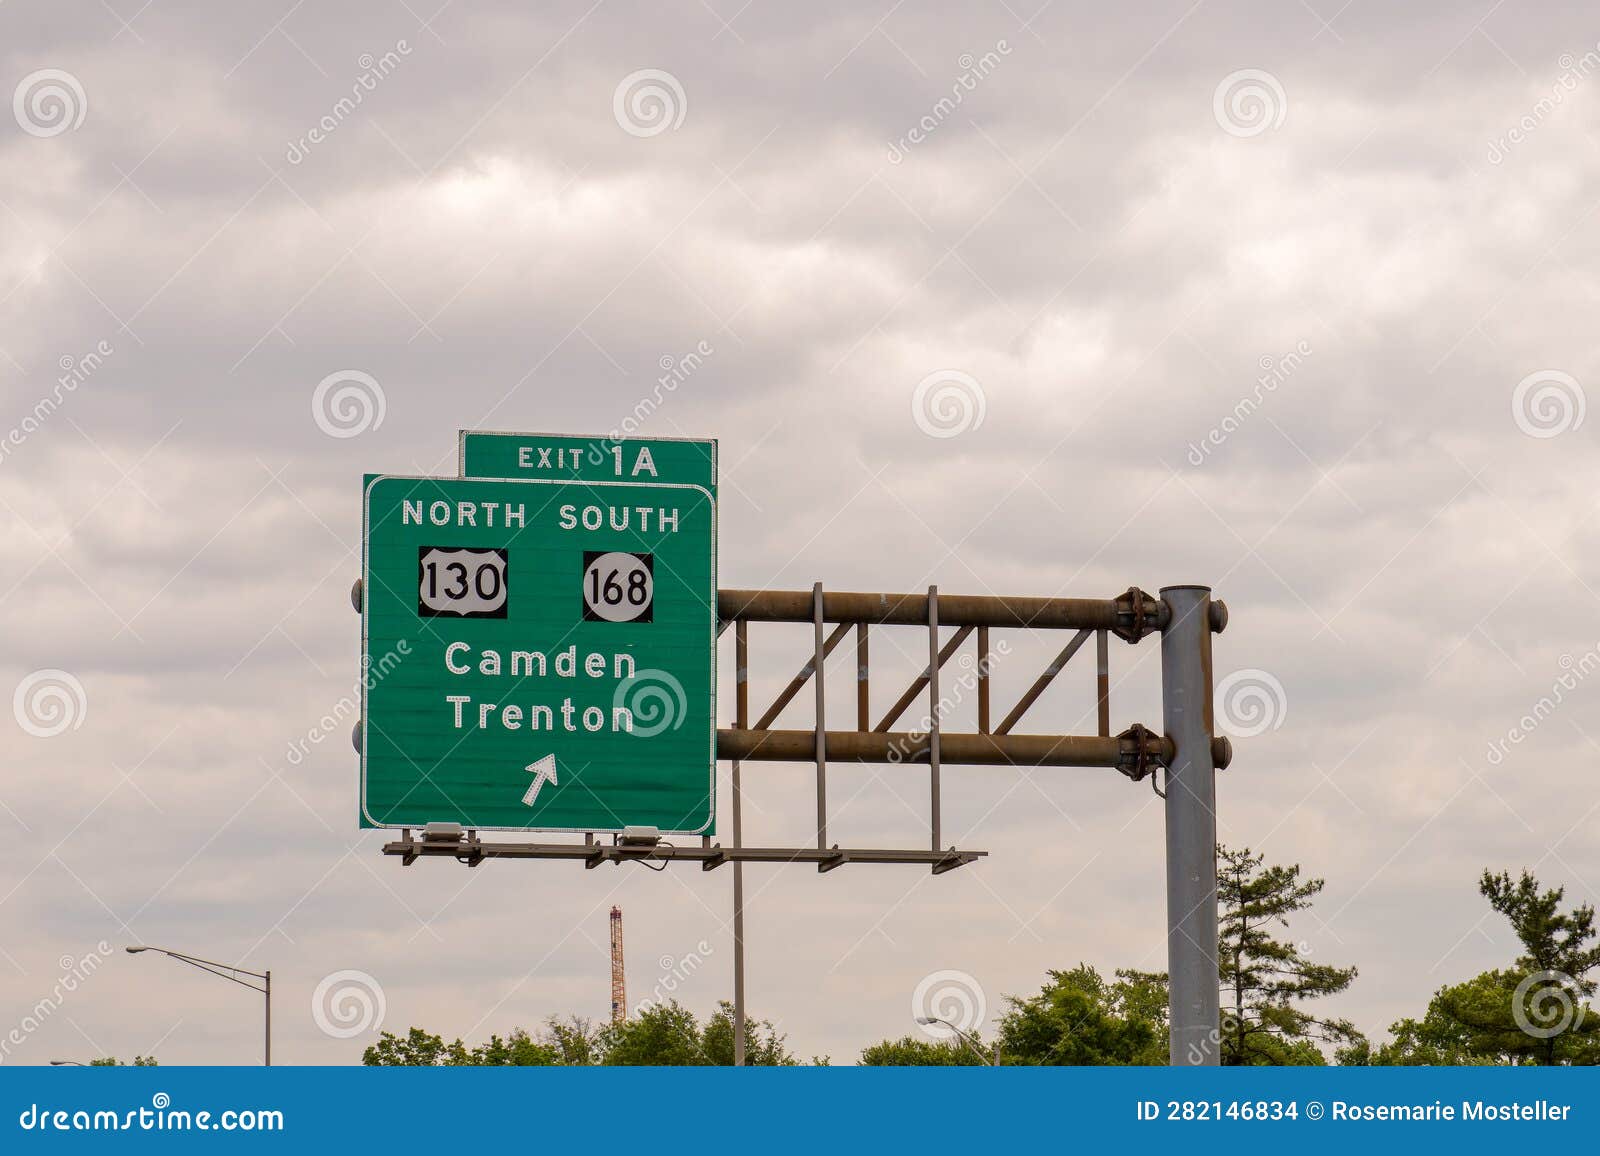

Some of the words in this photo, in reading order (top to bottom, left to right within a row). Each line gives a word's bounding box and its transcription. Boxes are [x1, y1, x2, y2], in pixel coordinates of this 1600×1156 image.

[518, 447, 584, 470] EXIT
[610, 444, 659, 477] 1A
[402, 499, 526, 528] NORTH
[558, 504, 679, 533] SOUTH
[426, 562, 501, 601] 130
[590, 568, 648, 606] 168
[445, 641, 636, 679] Camden
[446, 695, 634, 733] Trenton
